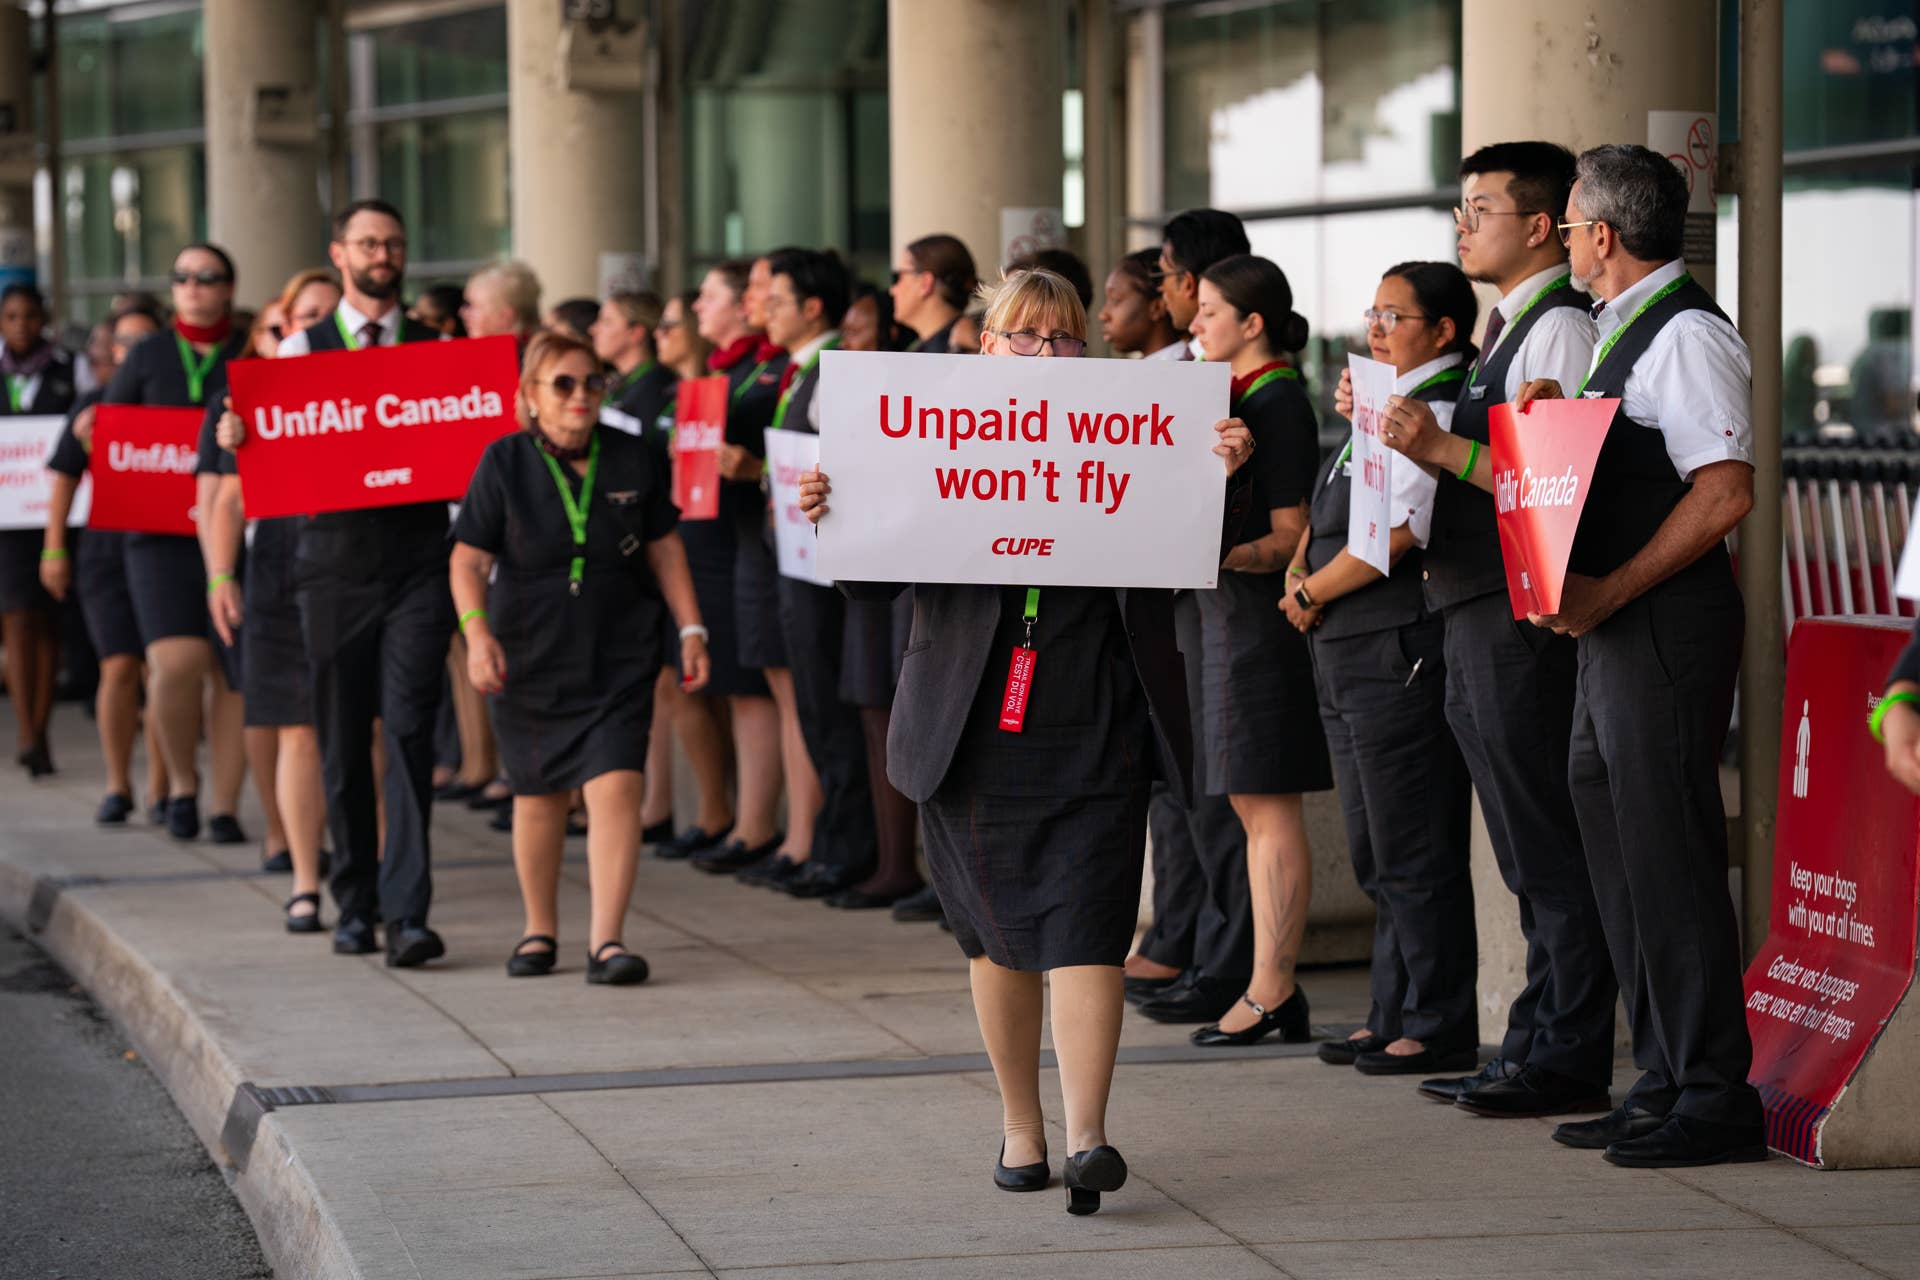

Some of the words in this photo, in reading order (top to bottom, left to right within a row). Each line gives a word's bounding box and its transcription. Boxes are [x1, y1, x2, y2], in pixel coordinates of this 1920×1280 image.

[255, 398, 367, 440] UnfAir
[375, 385, 503, 428] Canada
[880, 395, 1048, 450] Unpaid
[1067, 403, 1175, 446] work
[364, 467, 412, 488] CUPE
[935, 459, 1061, 502] won’t
[1077, 460, 1131, 514] fly
[1520, 465, 1579, 509] Canada
[992, 537, 1055, 556] CUPE
[1007, 695, 1017, 712] VOL
[1010, 681, 1019, 694] DU
[1790, 861, 1812, 898] Keep
[1814, 872, 1834, 902] your
[1835, 870, 1857, 910] bags
[1788, 897, 1807, 928] with
[1808, 909, 1825, 939] you
[1825, 912, 1836, 936] at
[1837, 912, 1849, 939] all
[1849, 913, 1875, 948] times.
[1767, 954, 1803, 985] Gardez
[1798, 968, 1820, 990] vos
[1813, 967, 1860, 1005] bagages
[1746, 990, 1774, 1013] avec
[1768, 997, 1795, 1020] vous
[1788, 1003, 1807, 1023] en
[1801, 1003, 1829, 1030] tout
